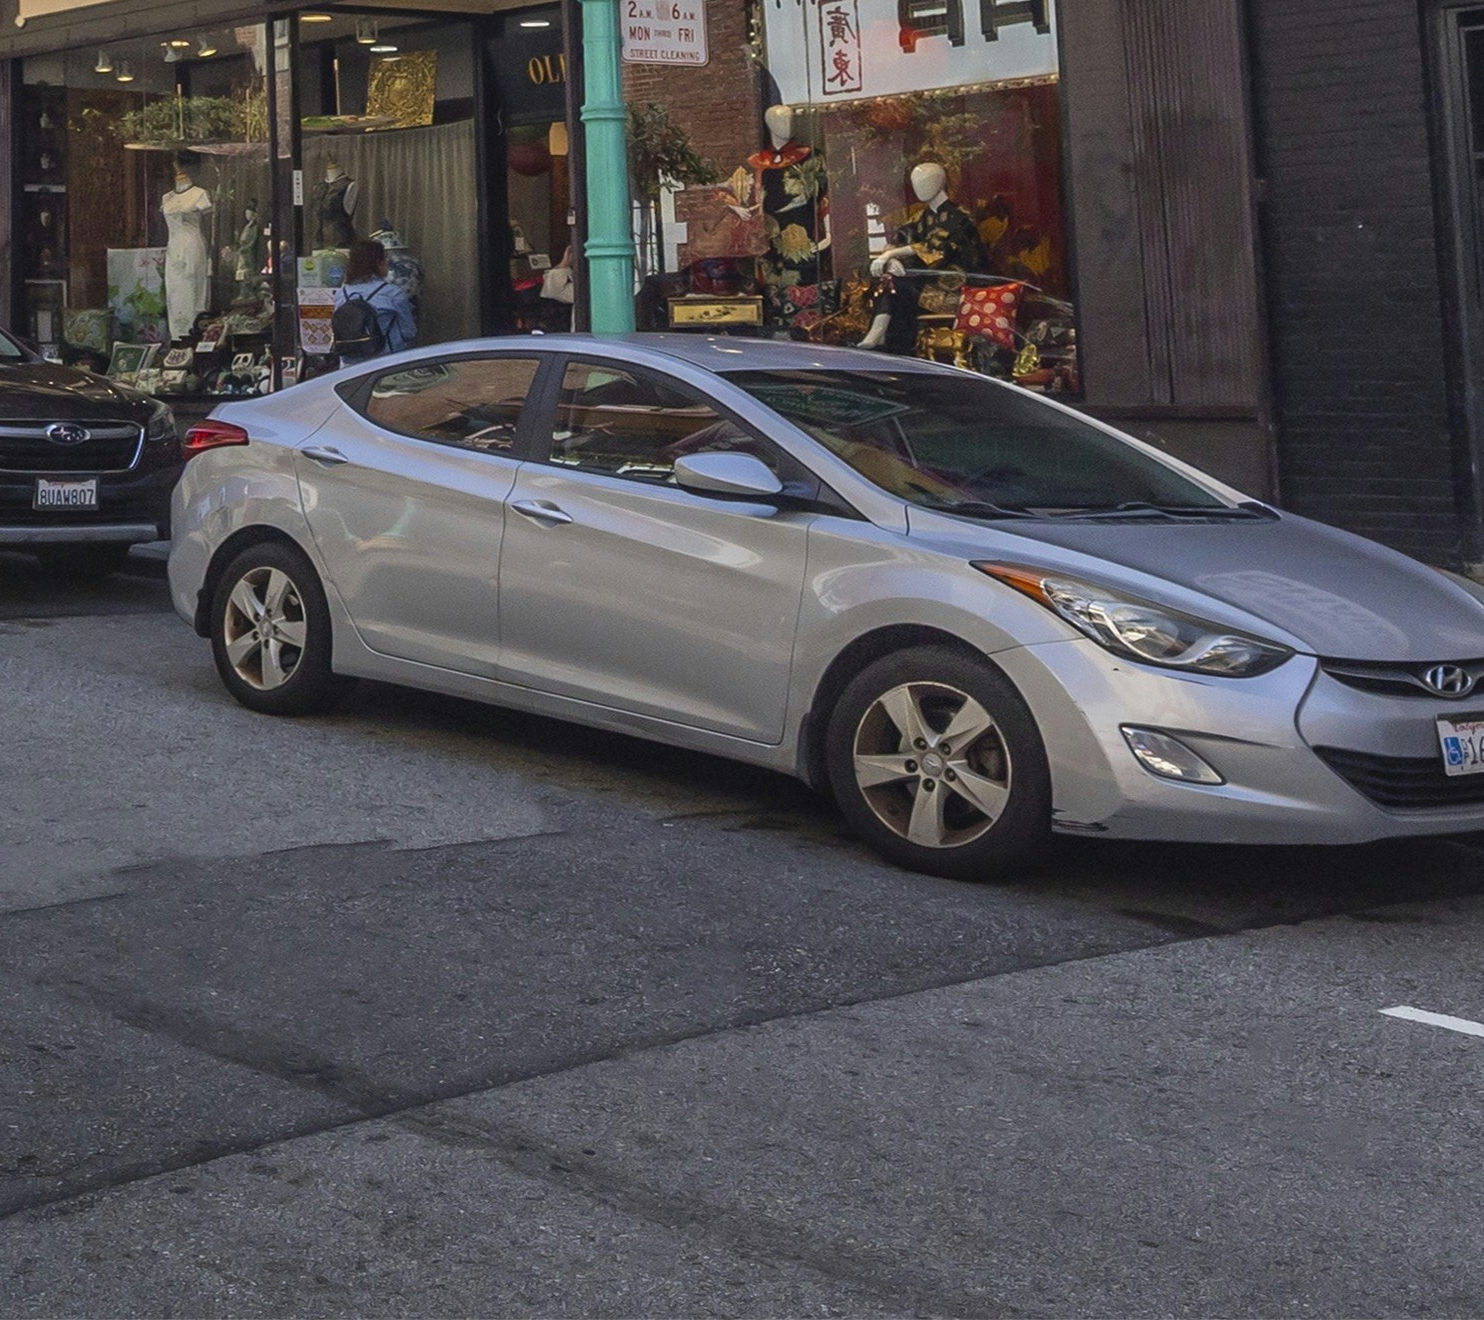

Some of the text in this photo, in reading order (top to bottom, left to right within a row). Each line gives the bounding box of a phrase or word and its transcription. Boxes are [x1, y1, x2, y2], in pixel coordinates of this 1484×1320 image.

[629, 26, 651, 42] MON
[678, 27, 695, 43] FRI
[629, 48, 701, 62] STREET CLEANING
